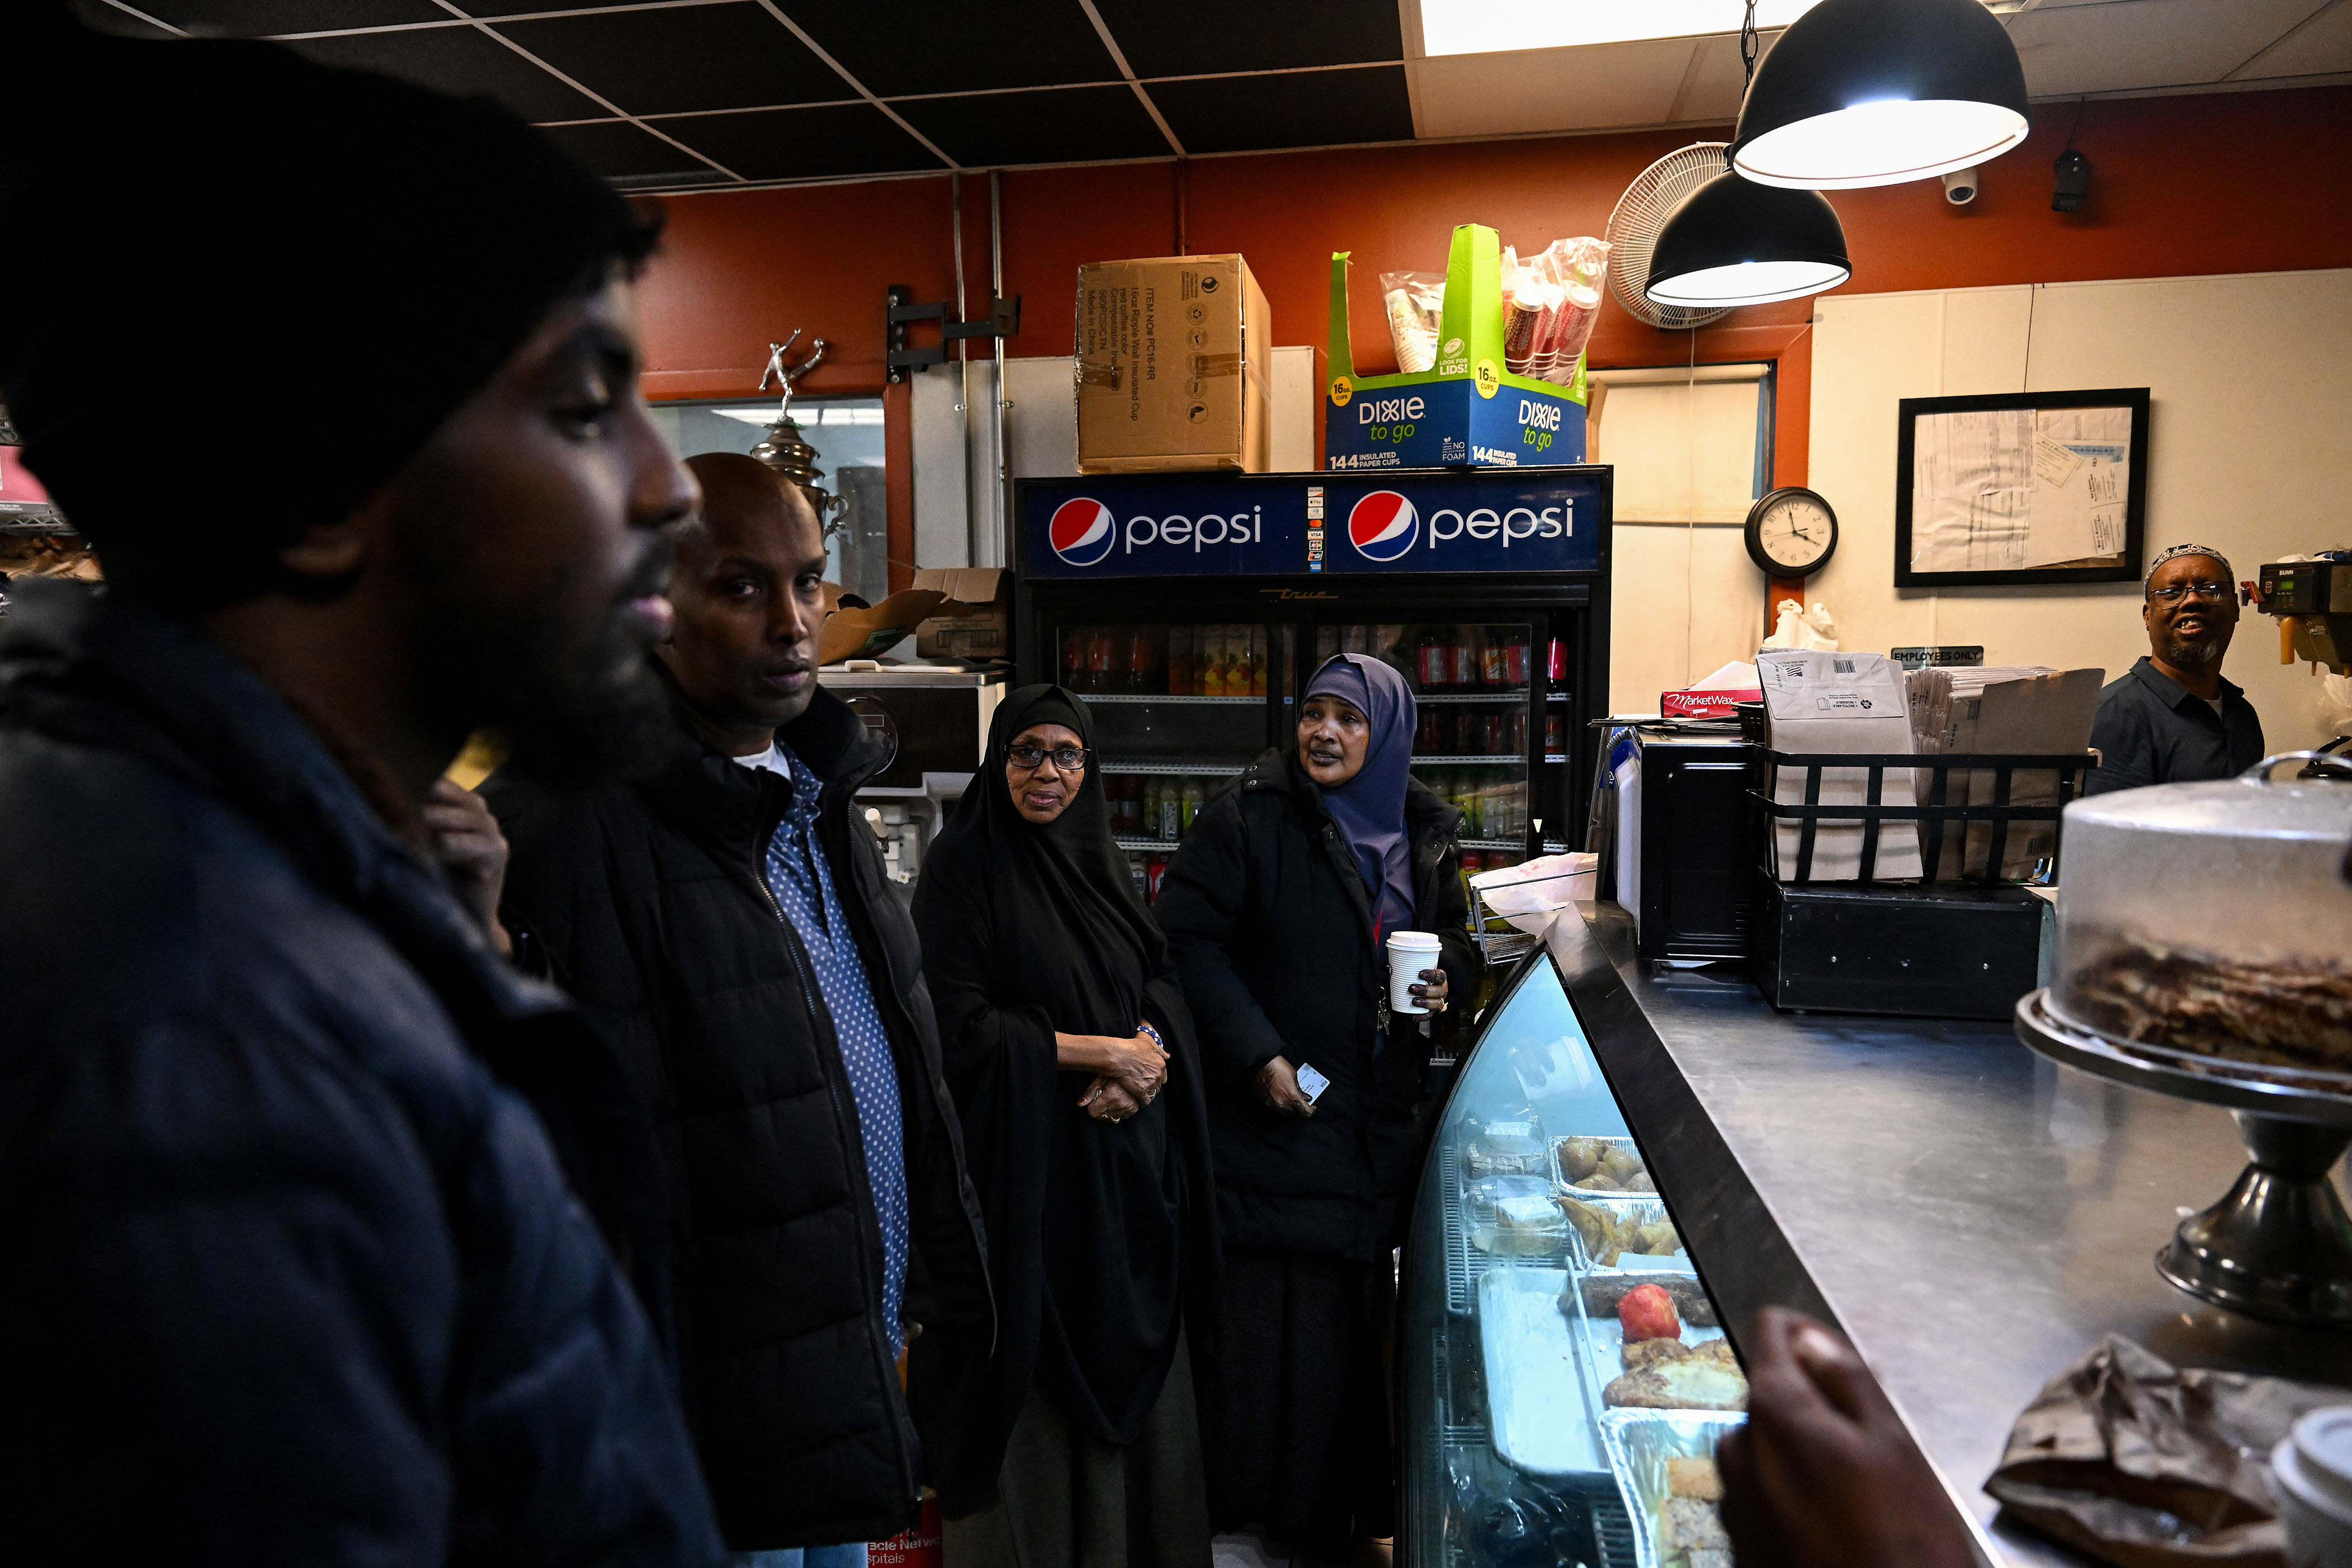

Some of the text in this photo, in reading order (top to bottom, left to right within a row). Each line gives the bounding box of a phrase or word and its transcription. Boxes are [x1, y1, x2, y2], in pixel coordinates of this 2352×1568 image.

[1088, 290, 1096, 315] Made
[1109, 288, 1119, 348] Compostable
[1120, 305, 1128, 332] coffee
[1131, 309, 1140, 338] Ripple
[1088, 329, 1096, 355] China
[1146, 288, 1155, 380] ITEM NO# PC16-RR
[1131, 339, 1140, 358] Wall
[1439, 363, 1468, 376] LIDS!
[1131, 361, 1140, 401] Insulated
[1130, 403, 1140, 421] Cup
[1370, 423, 1415, 444] to go
[1523, 426, 1552, 452] to go
[1330, 451, 1396, 470] 144 INSULATED
[1442, 452, 1465, 461] FOAM
[1472, 445, 1517, 463] 144 INSULATED
[1493, 457, 1506, 466] PAPER
[1359, 460, 1381, 468] PAPER
[1778, 505, 1786, 514] 11
[1792, 502, 1799, 510] 12
[1429, 498, 1574, 549] pepsi
[1767, 514, 1776, 523] 10
[1126, 505, 1261, 554] pepsi
[1894, 651, 1979, 662] EMPLOYEES ONLY
[1666, 693, 1734, 709] MarketWax
